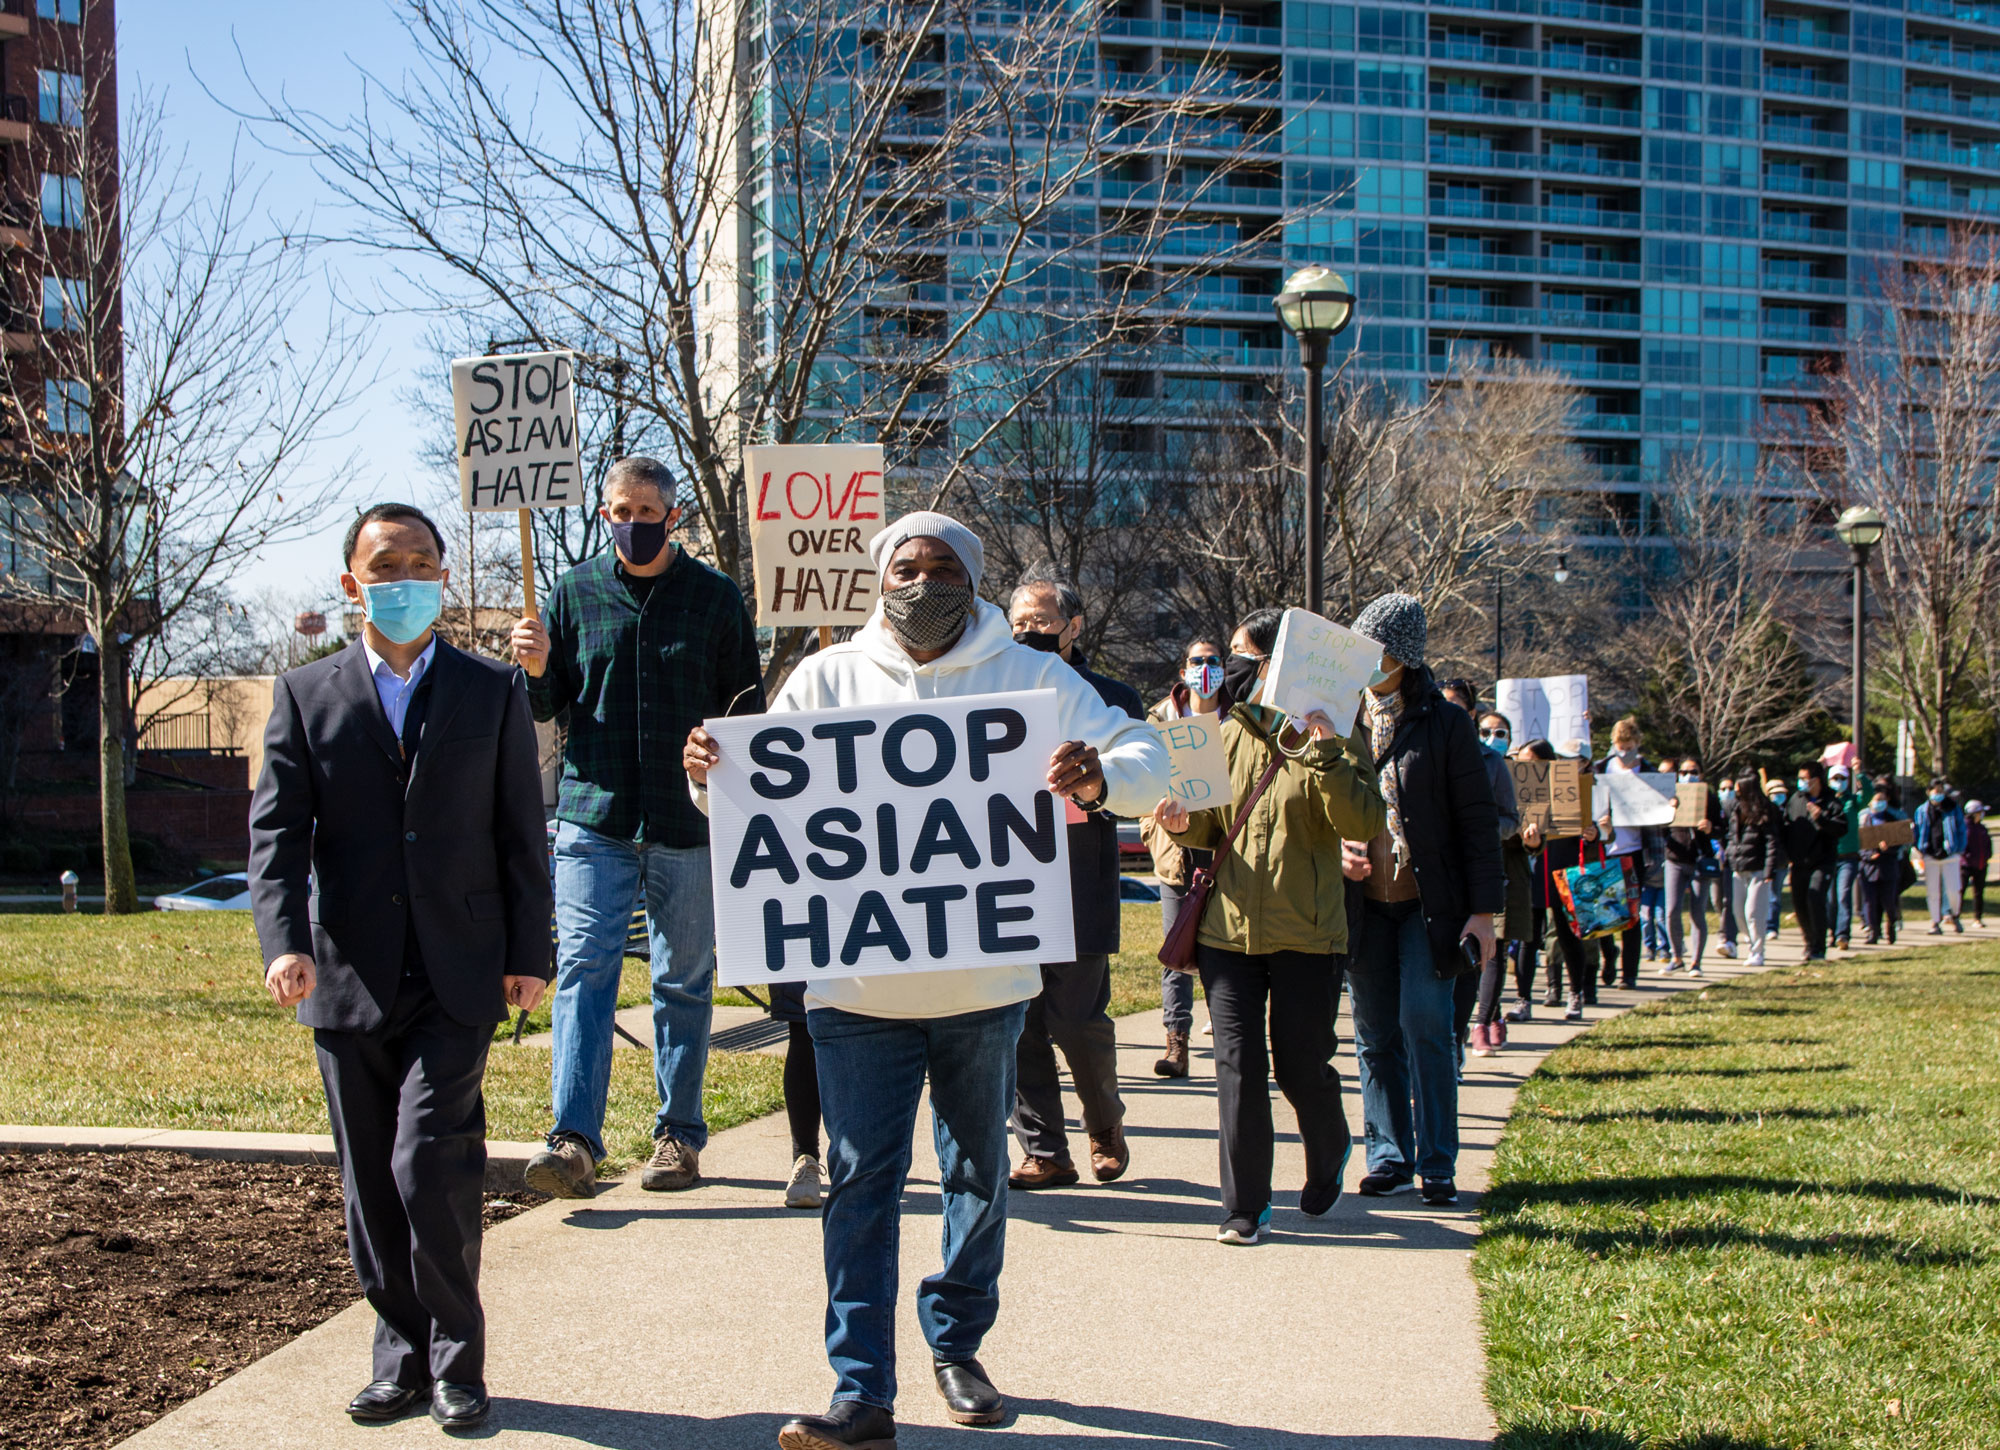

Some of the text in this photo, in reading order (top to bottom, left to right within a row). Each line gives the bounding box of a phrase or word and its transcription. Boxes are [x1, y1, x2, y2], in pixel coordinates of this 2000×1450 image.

[470, 357, 573, 415] STOP
[462, 414, 574, 457] ASIAN
[472, 461, 573, 507] HATE
[757, 471, 882, 522] LOVE
[788, 526, 865, 557] OVER
[772, 566, 877, 613] HATE
[1305, 650, 1350, 673] ASIAN
[1308, 626, 1356, 654] STOP
[1305, 673, 1337, 691] HATE
[1505, 681, 1584, 712] STOP
[749, 707, 1027, 800] STOP
[1158, 724, 1208, 750] ED
[1513, 761, 1572, 784] OVE
[730, 789, 1057, 889] ASIAN
[762, 878, 1041, 972] HATE
